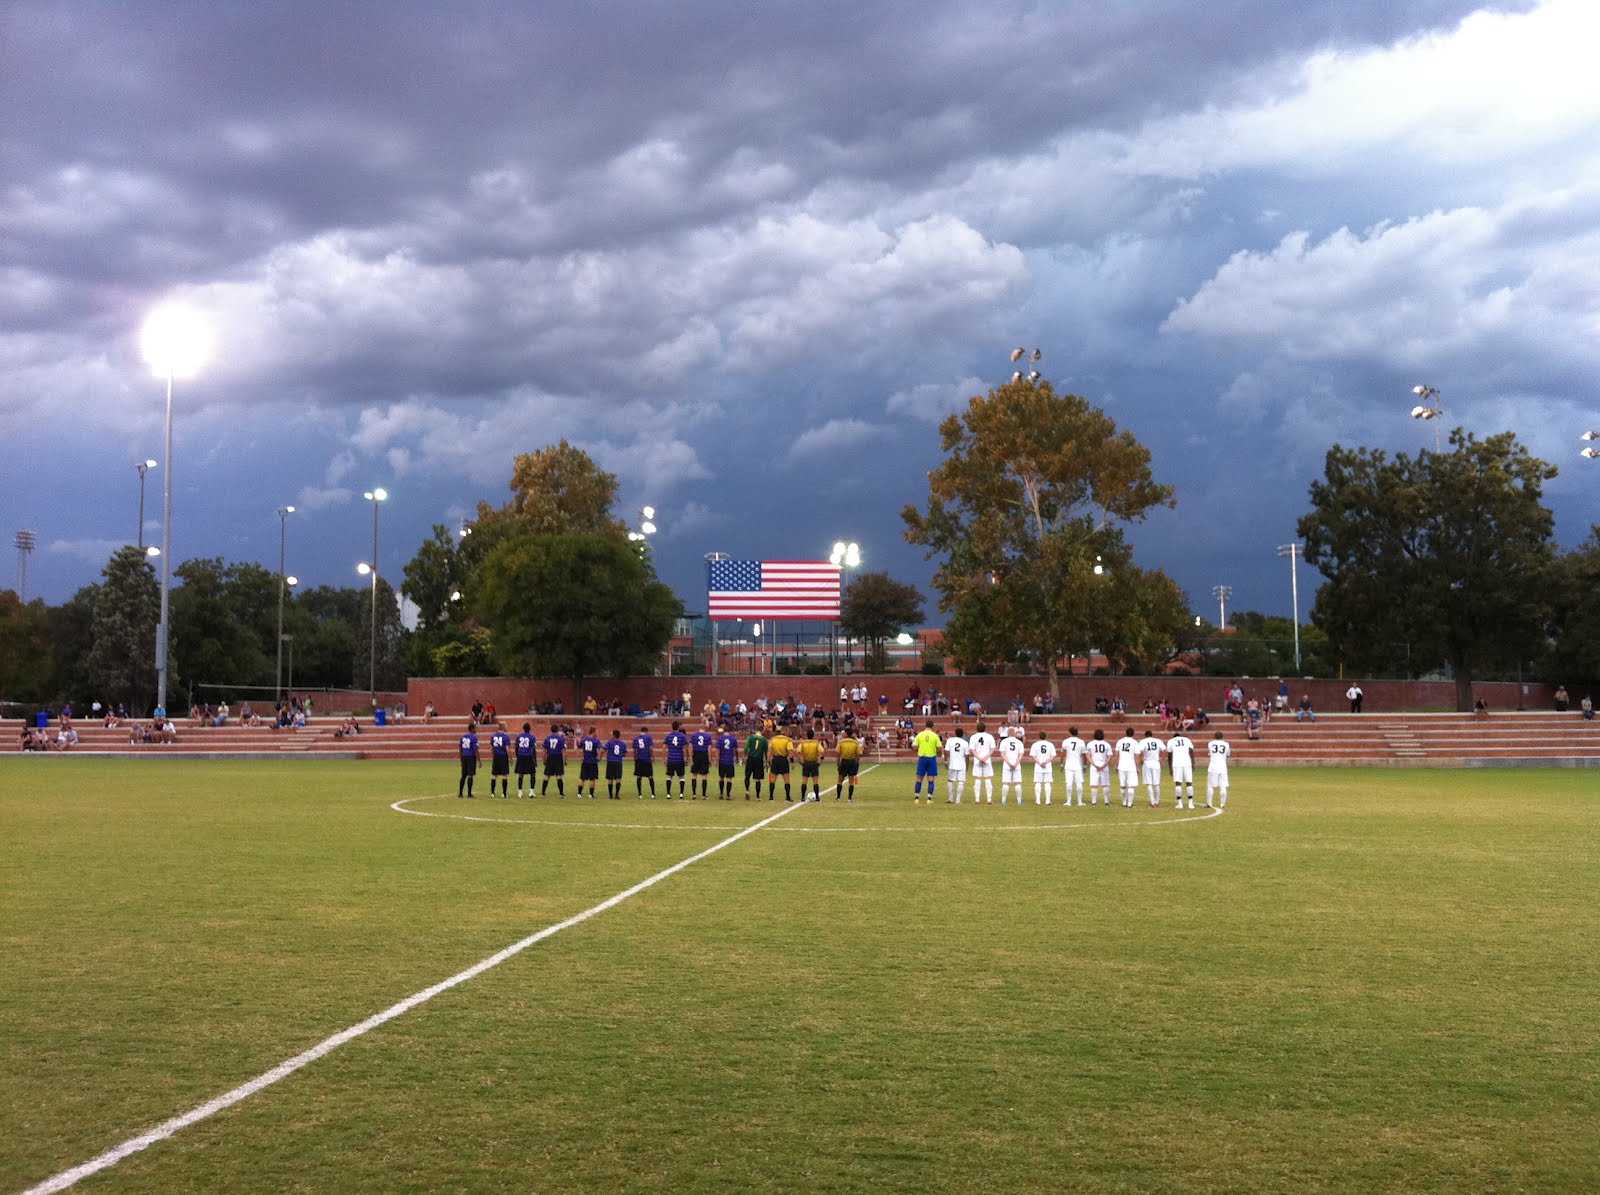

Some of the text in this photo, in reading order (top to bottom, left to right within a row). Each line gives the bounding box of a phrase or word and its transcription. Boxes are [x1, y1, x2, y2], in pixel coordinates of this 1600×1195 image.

[493, 736, 502, 746] 24
[519, 737, 530, 748] 23
[550, 738, 558, 749] 17
[638, 738, 644, 748] 5
[672, 736, 678, 746] 4
[698, 736, 704, 746] 3
[724, 739, 730, 750] 2
[978, 737, 984, 745] 4
[584, 741, 593, 751] 10
[614, 744, 620, 755] 8
[954, 743, 960, 752] 2
[1010, 742, 1016, 750] 5
[1040, 745, 1046, 754] 6
[1070, 742, 1076, 750] 7
[1094, 744, 1105, 753] 10
[1122, 743, 1130, 752] 12
[1146, 742, 1157, 750] 19
[1212, 745, 1226, 754] 33
